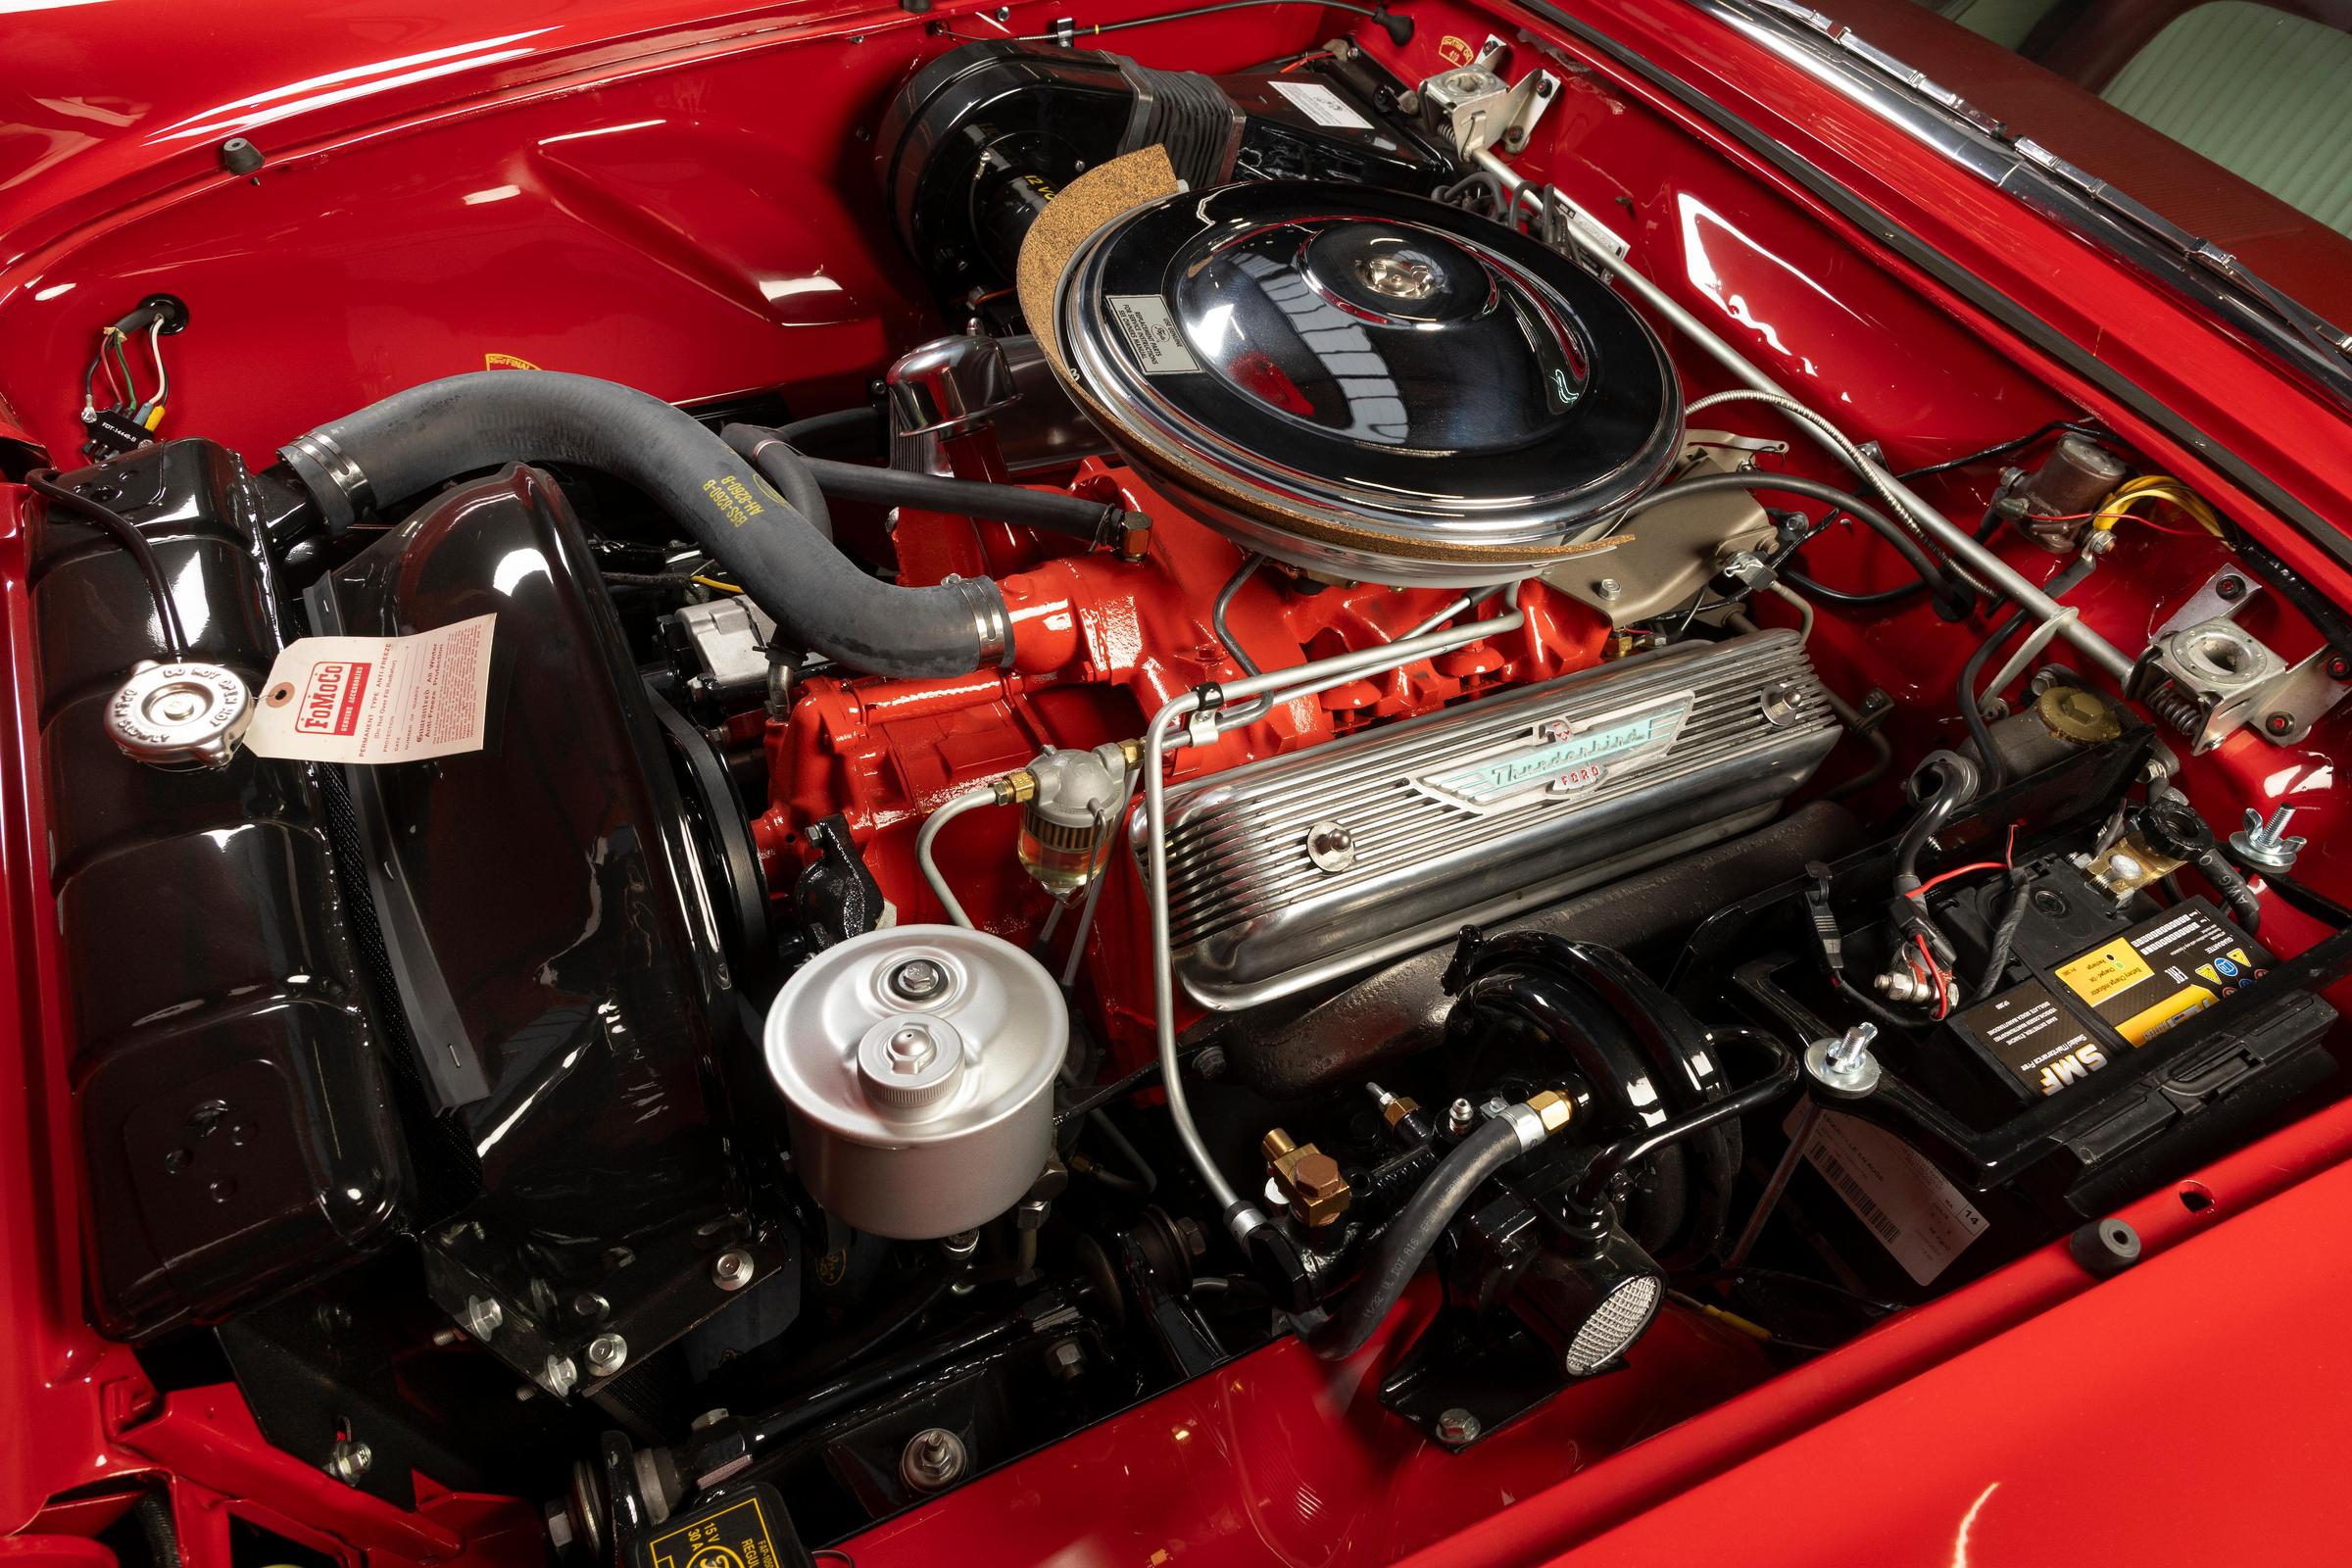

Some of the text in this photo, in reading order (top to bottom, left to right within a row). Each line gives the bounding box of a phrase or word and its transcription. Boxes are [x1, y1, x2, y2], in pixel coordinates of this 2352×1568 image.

[1024, 173, 1044, 187] 12
[1118, 308, 1148, 360] SEE OWNERS MANUAL
[1122, 303, 1158, 366] FOR SERVICE INSTRUCTIONS
[1134, 311, 1154, 342] REPLACEMENT
[1150, 341, 1162, 357] PARTS
[1162, 317, 1183, 348] USE GENUINE
[700, 476, 749, 528] B5S-8260-B
[719, 472, 764, 516] AH-8260-B
[163, 667, 185, 678] DO
[190, 667, 220, 679] NOT
[209, 707, 233, 727] HOT
[303, 662, 343, 731] FoMoCo
[340, 664, 364, 731] GENUINE ACCESSORIES
[358, 642, 392, 757] PERMANENT TYPE ANTI-FREEZE
[378, 699, 388, 713] Over
[415, 688, 430, 743] Guaranteed
[428, 642, 437, 669] Winter
[423, 642, 444, 737] Anti-Freeze Protection
[114, 688, 170, 743] OPEN SLOWLY
[382, 714, 395, 753] PROTECTION
[404, 684, 419, 750] NUMBER OF QUARTS
[1489, 723, 1646, 788] Thunderbird
[1559, 762, 1600, 787] FORD
[2217, 873, 2250, 906] AWG
[2203, 935, 2233, 956] GUARANTEE
[2089, 965, 2141, 997] Battery Charge Indicator
[2098, 966, 2115, 979] Charged
[2019, 1032, 2086, 1072] Sealed Maintenance Free
[2039, 1042, 2108, 1097] SMF
[1961, 1207, 1982, 1227] 14
[686, 1528, 704, 1552] 30 A
[702, 1522, 717, 1535] 15
[707, 1533, 720, 1544] V
